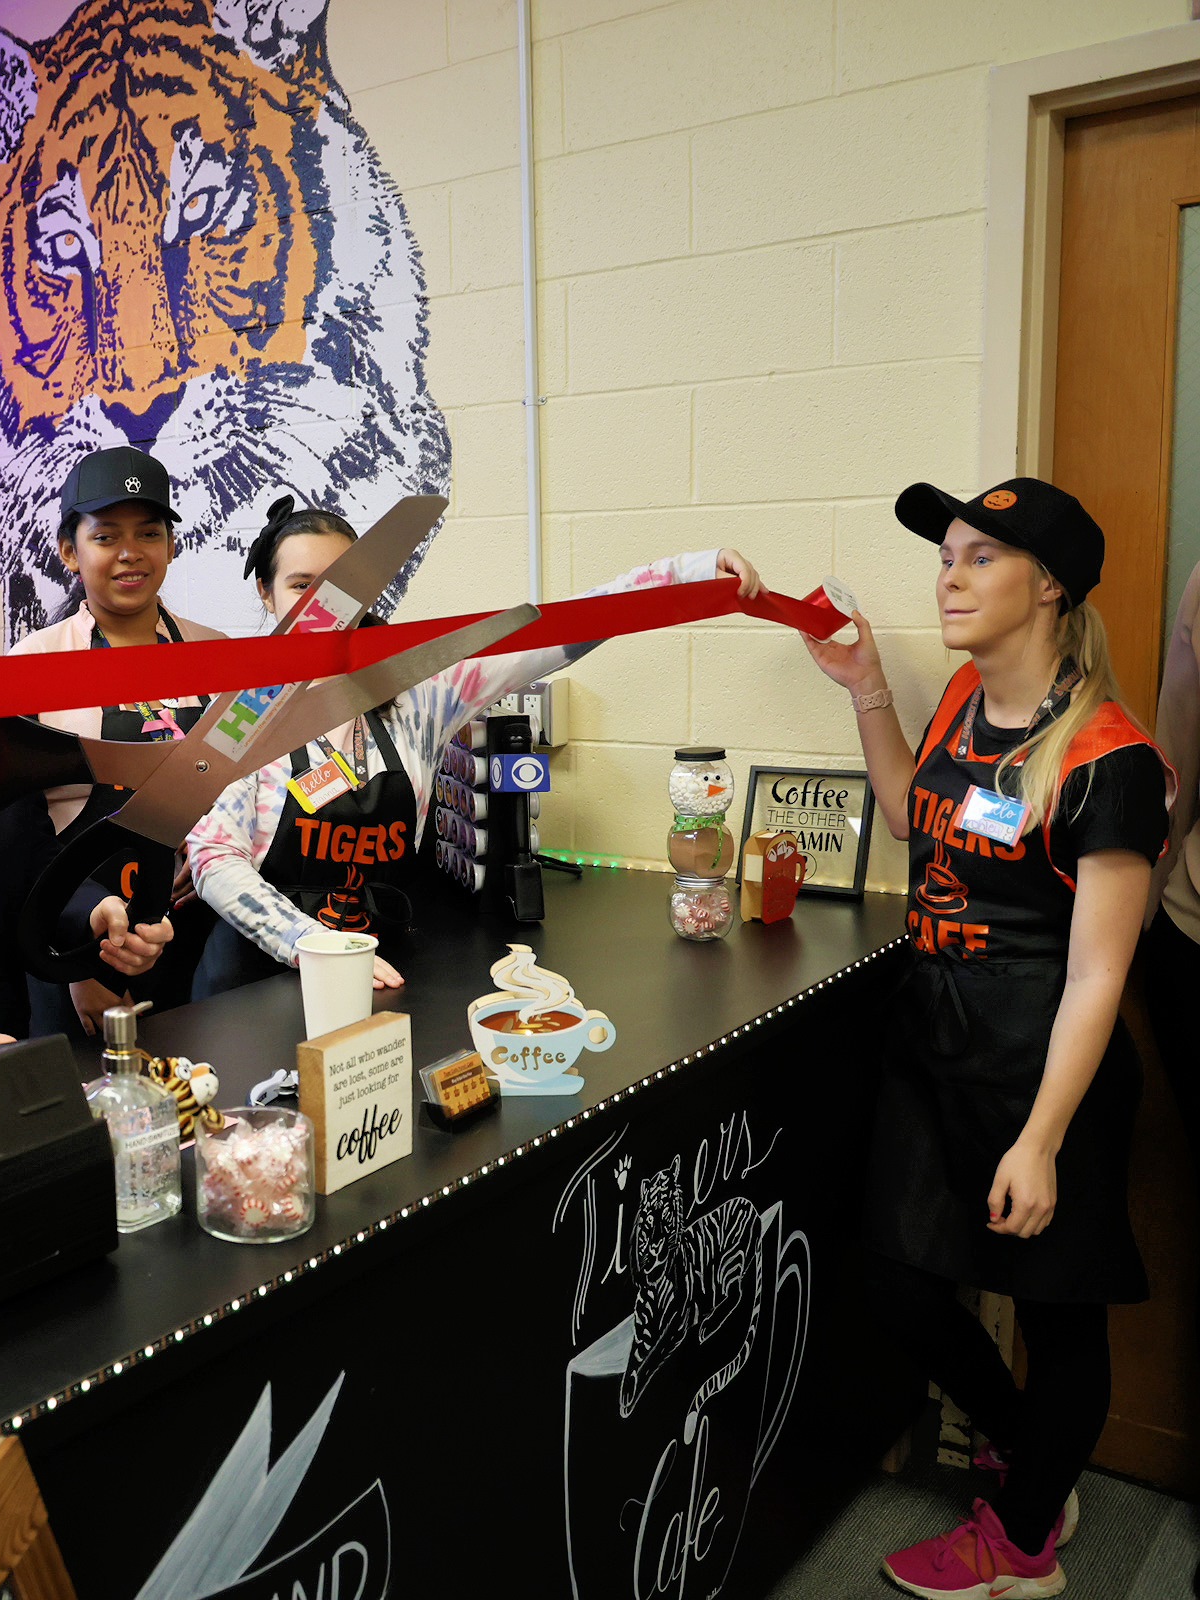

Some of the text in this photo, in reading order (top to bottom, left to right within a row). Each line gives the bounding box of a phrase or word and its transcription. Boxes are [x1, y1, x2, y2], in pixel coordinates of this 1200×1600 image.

[300, 768, 332, 797] hello
[771, 777, 849, 809] Coffee
[767, 809, 847, 828] THE OTHER
[295, 817, 407, 865] TIGERS
[766, 828, 844, 853] AMIN
[907, 910, 990, 960] CAFE
[329, 1037, 407, 1077] Not all who wander
[333, 1055, 404, 1093] are lost, some are
[490, 1046, 567, 1071] Coffee
[338, 1072, 400, 1109] just looking for
[336, 1104, 403, 1164] coffee
[552, 1110, 783, 1347] Tiers
